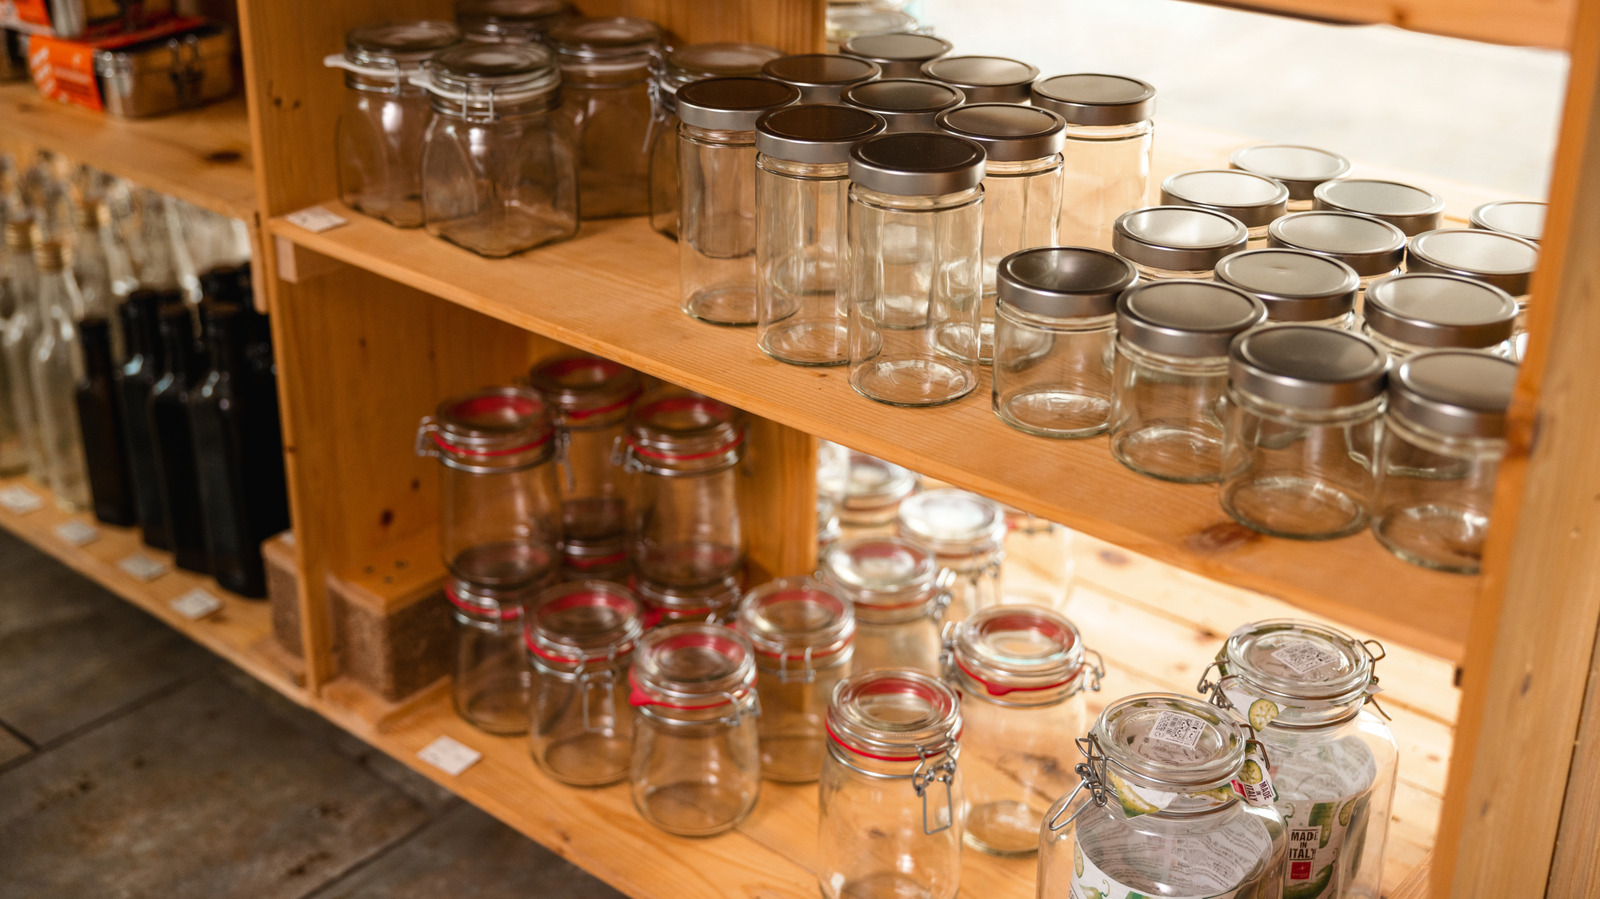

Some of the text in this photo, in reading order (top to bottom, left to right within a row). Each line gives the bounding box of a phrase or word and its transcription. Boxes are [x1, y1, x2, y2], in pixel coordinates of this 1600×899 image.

[1245, 783, 1259, 802] ITALY
[1259, 780, 1272, 800] MADE
[1291, 831, 1319, 842] MADE
[1289, 848, 1316, 859] ITALY
